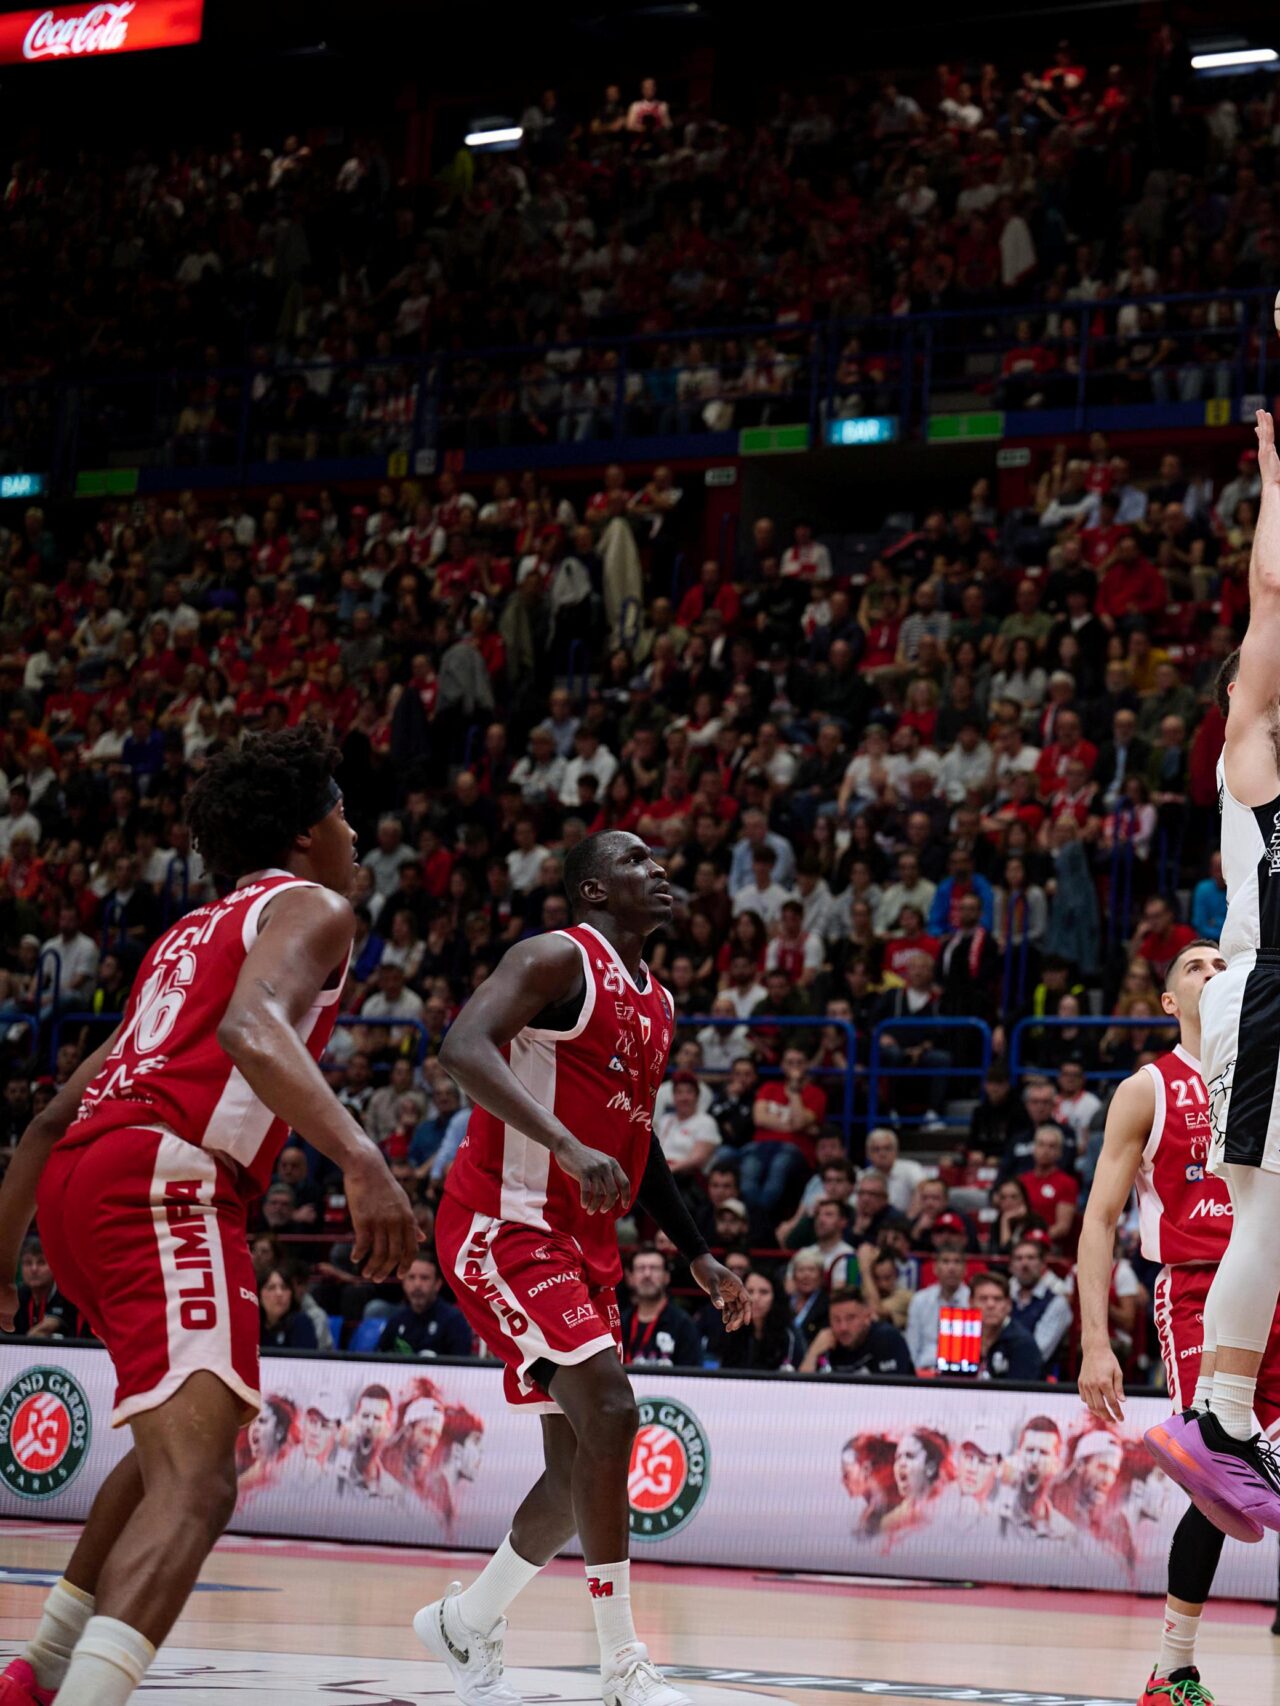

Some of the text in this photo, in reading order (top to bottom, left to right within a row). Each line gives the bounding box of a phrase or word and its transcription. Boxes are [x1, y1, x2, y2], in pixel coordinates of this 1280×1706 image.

[23, 1, 136, 59] Coca-Cola
[842, 419, 880, 443] BAR
[1, 475, 31, 497] BAR
[107, 950, 197, 1061] 16
[1170, 1075, 1208, 1108] 21
[1185, 1110, 1210, 1126] EA
[527, 1271, 580, 1299] DRIVAL
[562, 1303, 594, 1325] EA7
[49, 1374, 87, 1450] GARROS
[659, 1405, 704, 1487] GARROS
